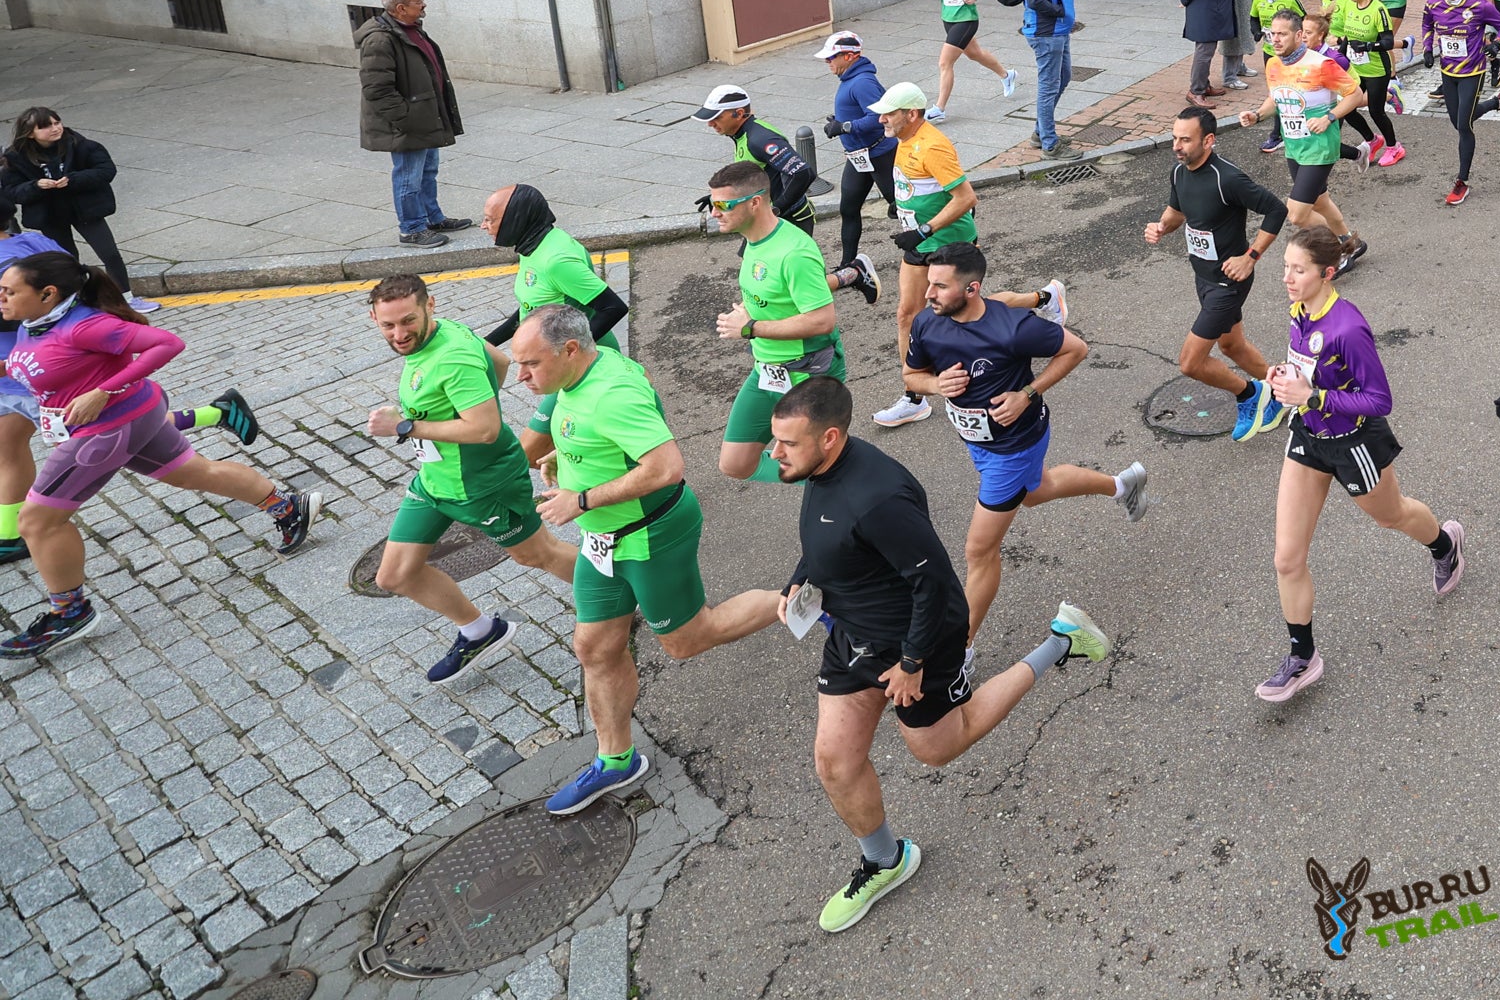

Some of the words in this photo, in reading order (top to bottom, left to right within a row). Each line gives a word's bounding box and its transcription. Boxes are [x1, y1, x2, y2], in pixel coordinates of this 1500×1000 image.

[1447, 41, 1459, 50] 69
[1284, 120, 1302, 130] 107
[950, 411, 982, 430] 152
